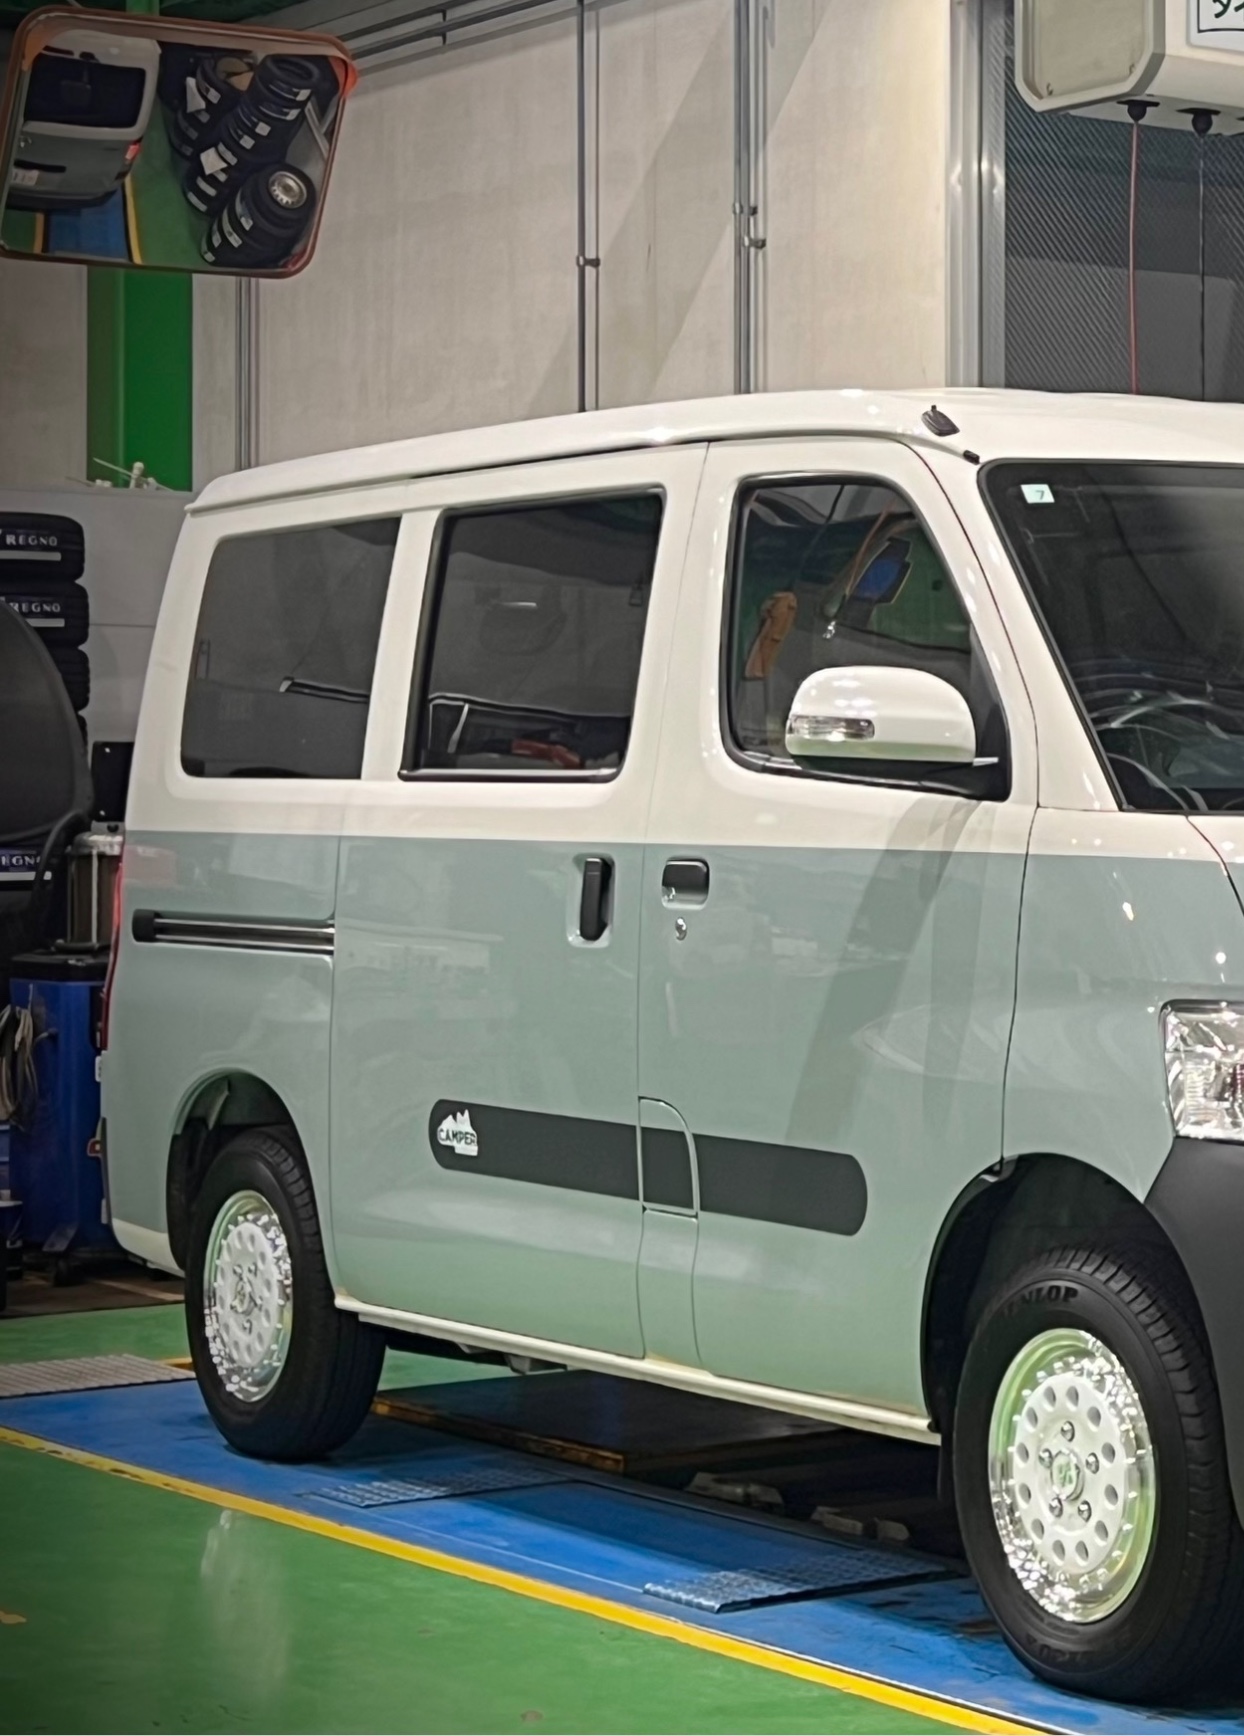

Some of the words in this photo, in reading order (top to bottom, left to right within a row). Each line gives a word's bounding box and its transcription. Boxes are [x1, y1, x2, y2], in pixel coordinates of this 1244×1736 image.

[5, 533, 59, 547] REGNO
[8, 602, 62, 613] REGNO
[438, 1128, 477, 1145] CAMPER
